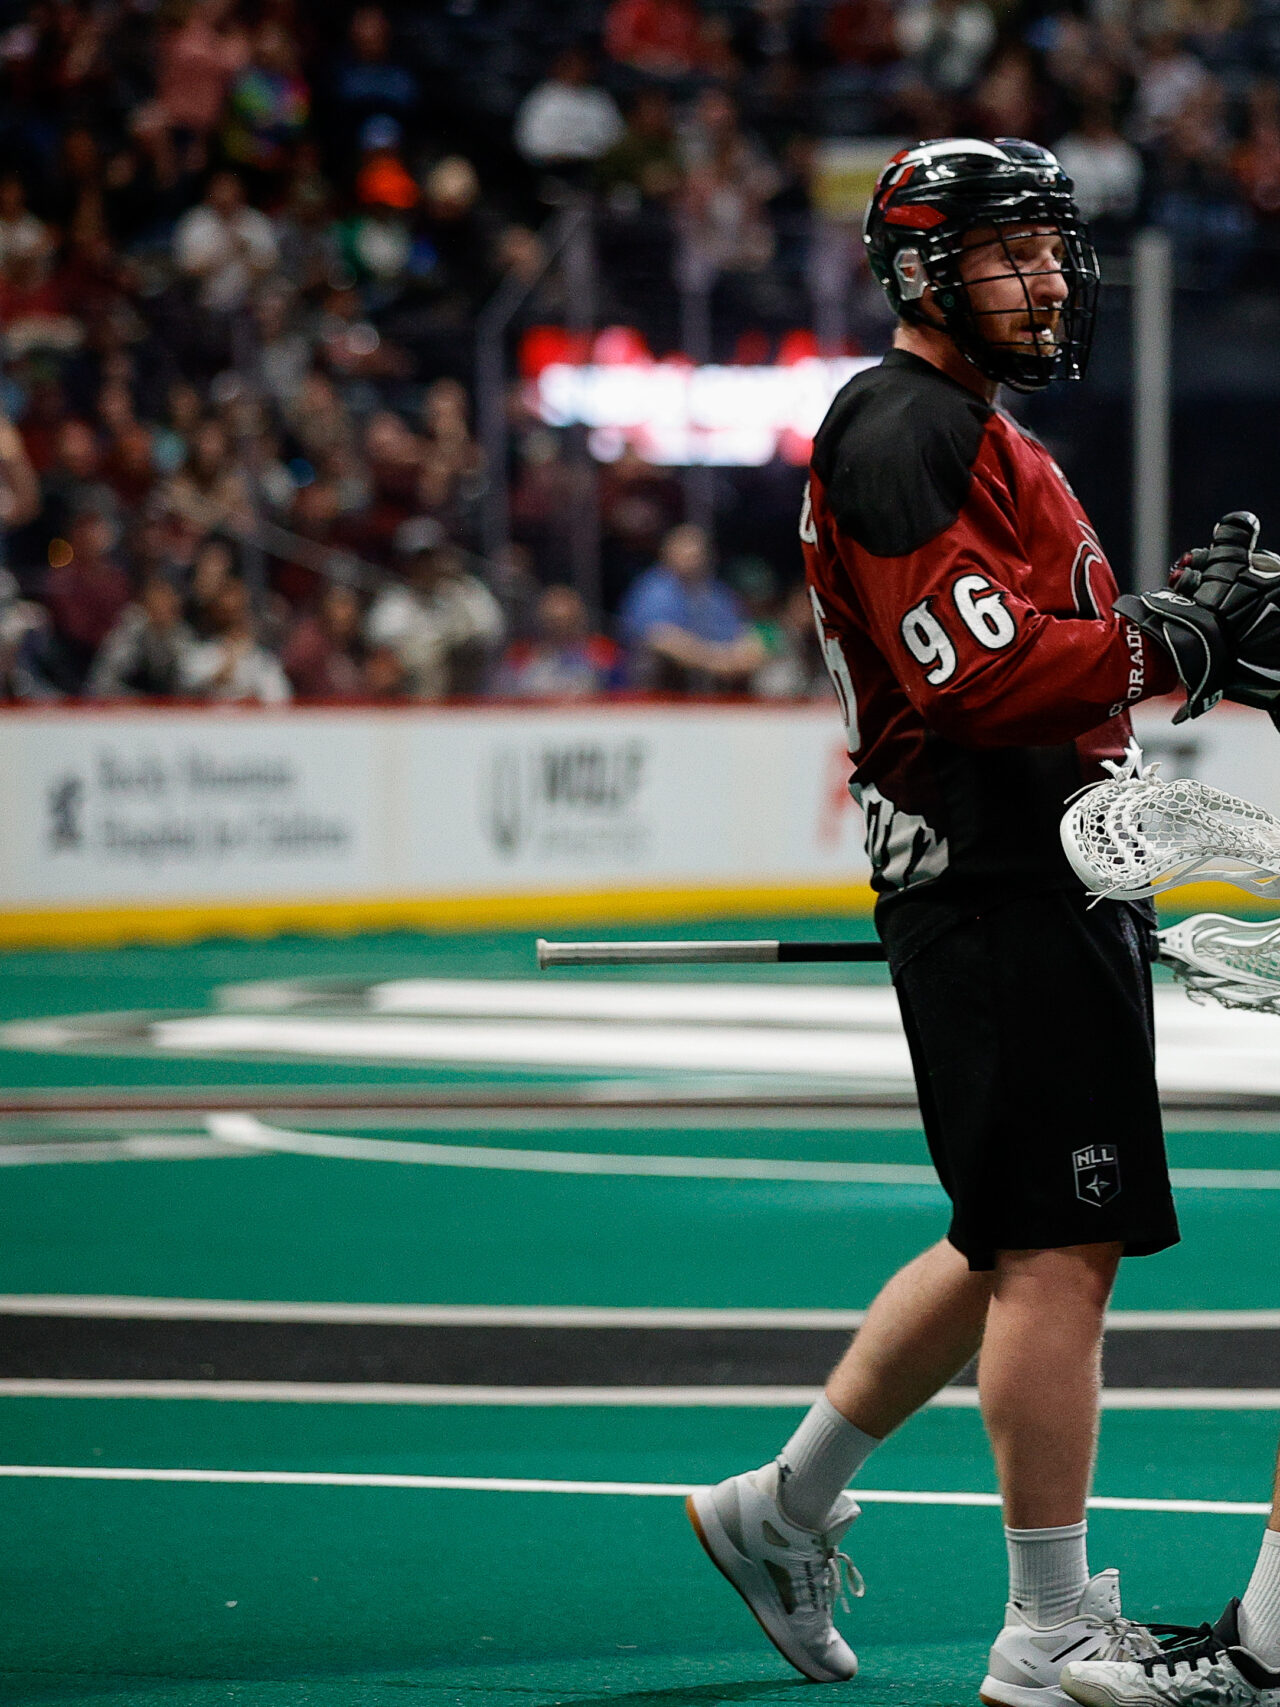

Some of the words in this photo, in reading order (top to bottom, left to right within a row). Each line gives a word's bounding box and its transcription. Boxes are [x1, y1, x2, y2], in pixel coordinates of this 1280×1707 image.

[901, 573, 1018, 686] 96
[1109, 624, 1146, 717] CORADO
[1076, 1146, 1115, 1167] NLL
